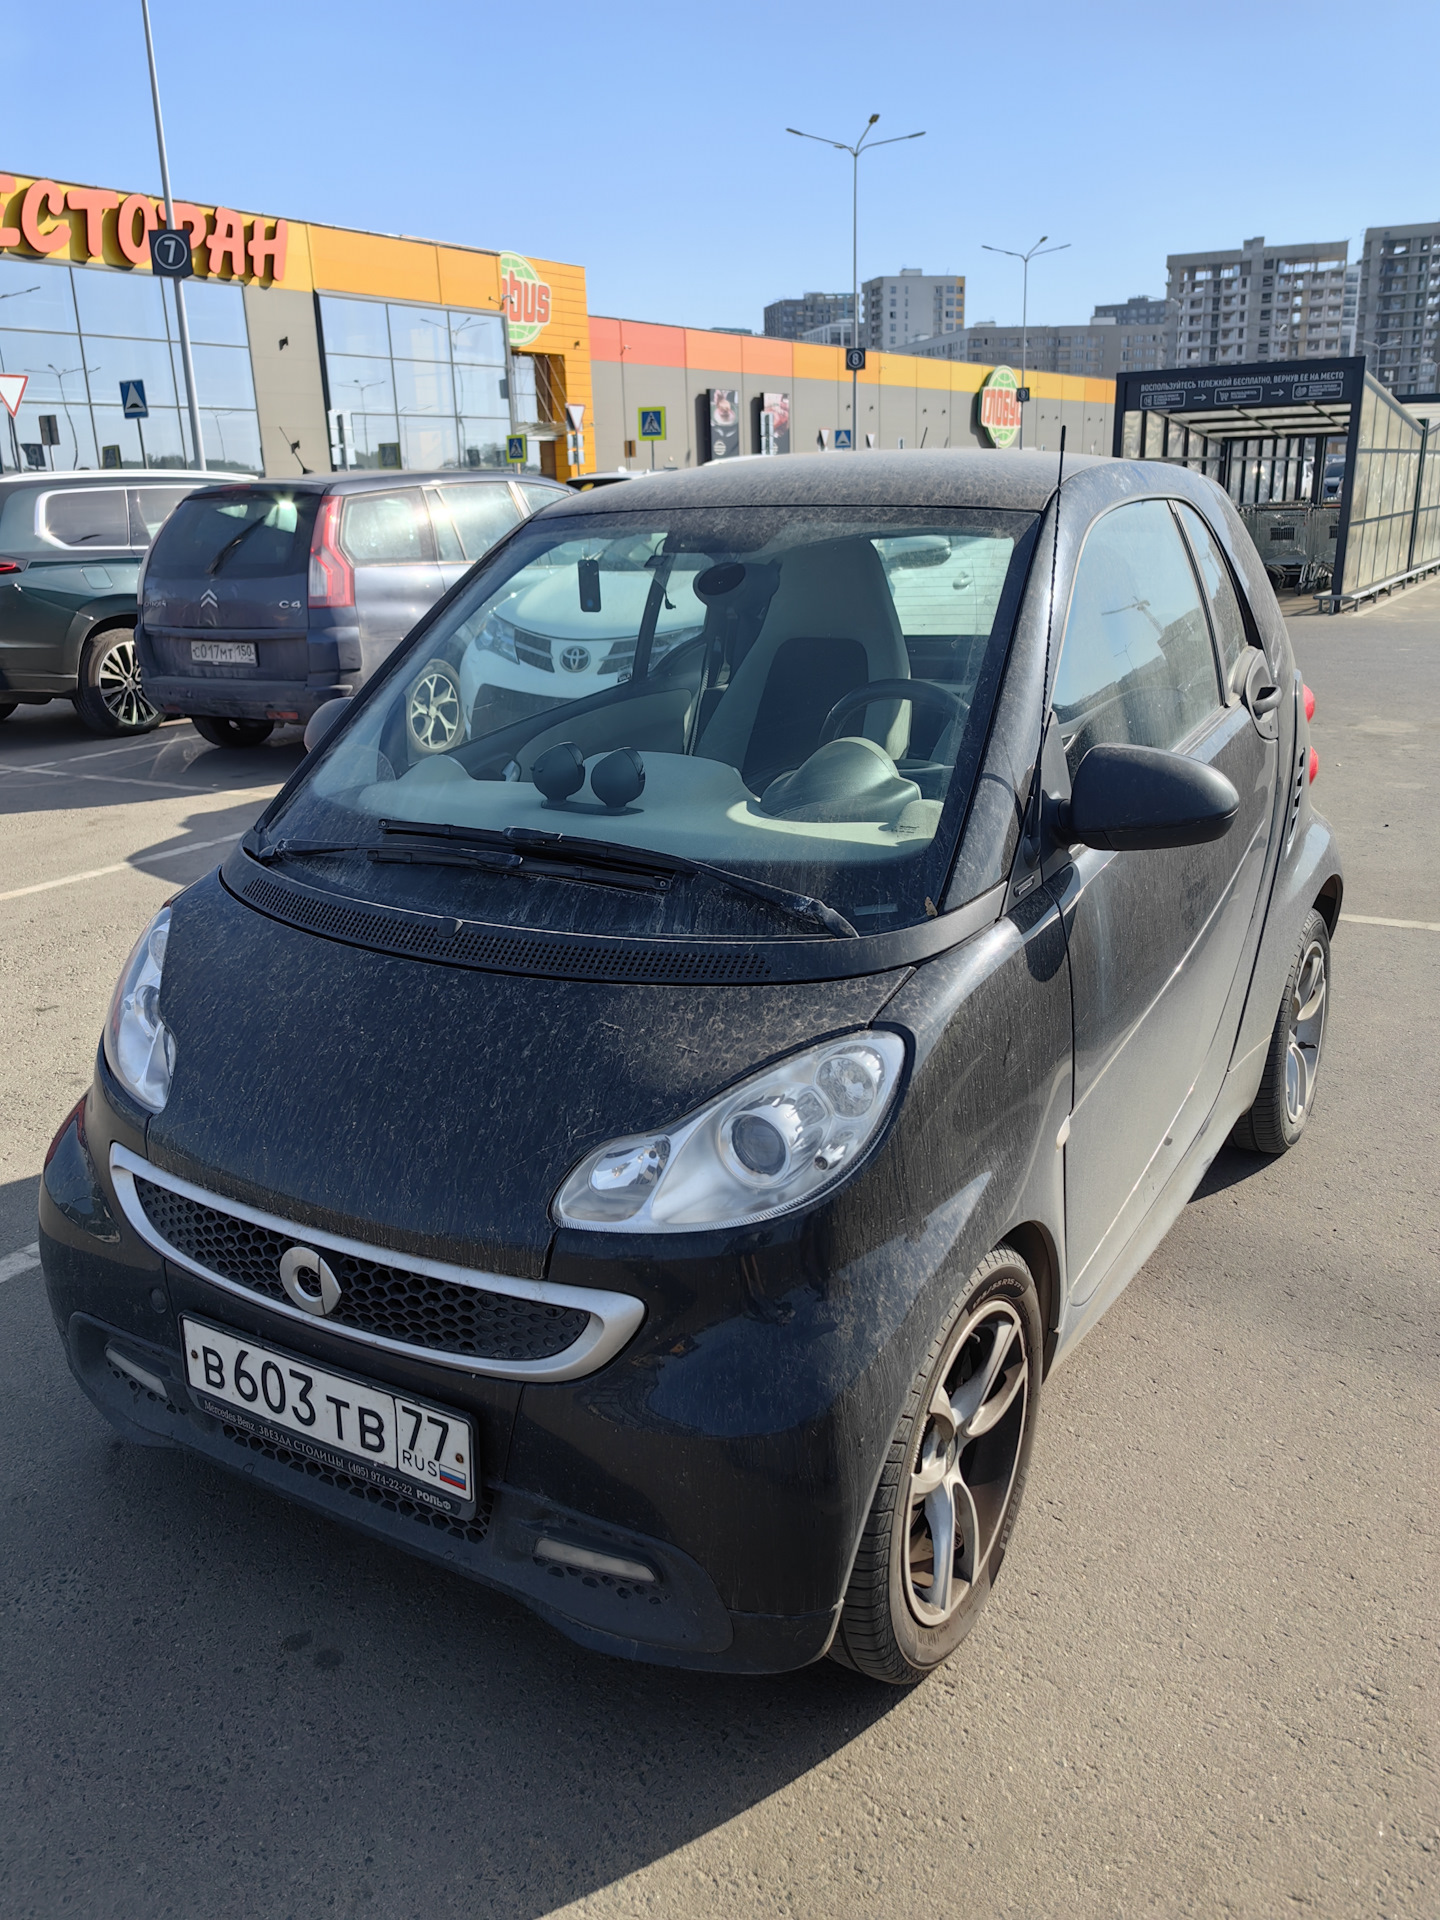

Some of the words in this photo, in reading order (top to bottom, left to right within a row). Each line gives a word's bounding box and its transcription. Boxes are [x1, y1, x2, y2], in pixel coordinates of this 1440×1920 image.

[164, 241, 176, 263] 7
[1141, 380, 1197, 392] ВОСПОЛЬЗУЙТЕСЬ
[1198, 377, 1232, 388] ТЕЛЕЖКОЙ
[1233, 376, 1272, 386] БЕСПЛАТНО,
[1273, 374, 1299, 383] ВЕРНУВ
[1300, 373, 1309, 382] ЕЕ
[1310, 372, 1319, 381] НА
[1320, 371, 1344, 380] МЕСТО
[278, 600, 302, 609] C4
[235, 645, 252, 657] 150
[401, 1405, 449, 1462] 77
[258, 1424, 293, 1447] ЗВЕЗДА
[293, 1439, 344, 1469] СТОЛИЦЫ
[347, 1461, 370, 1480] (495)
[370, 1470, 413, 1496] 974-22-22
[416, 1489, 452, 1511] РОЛЬФ
[402, 1448, 438, 1477] RUS
